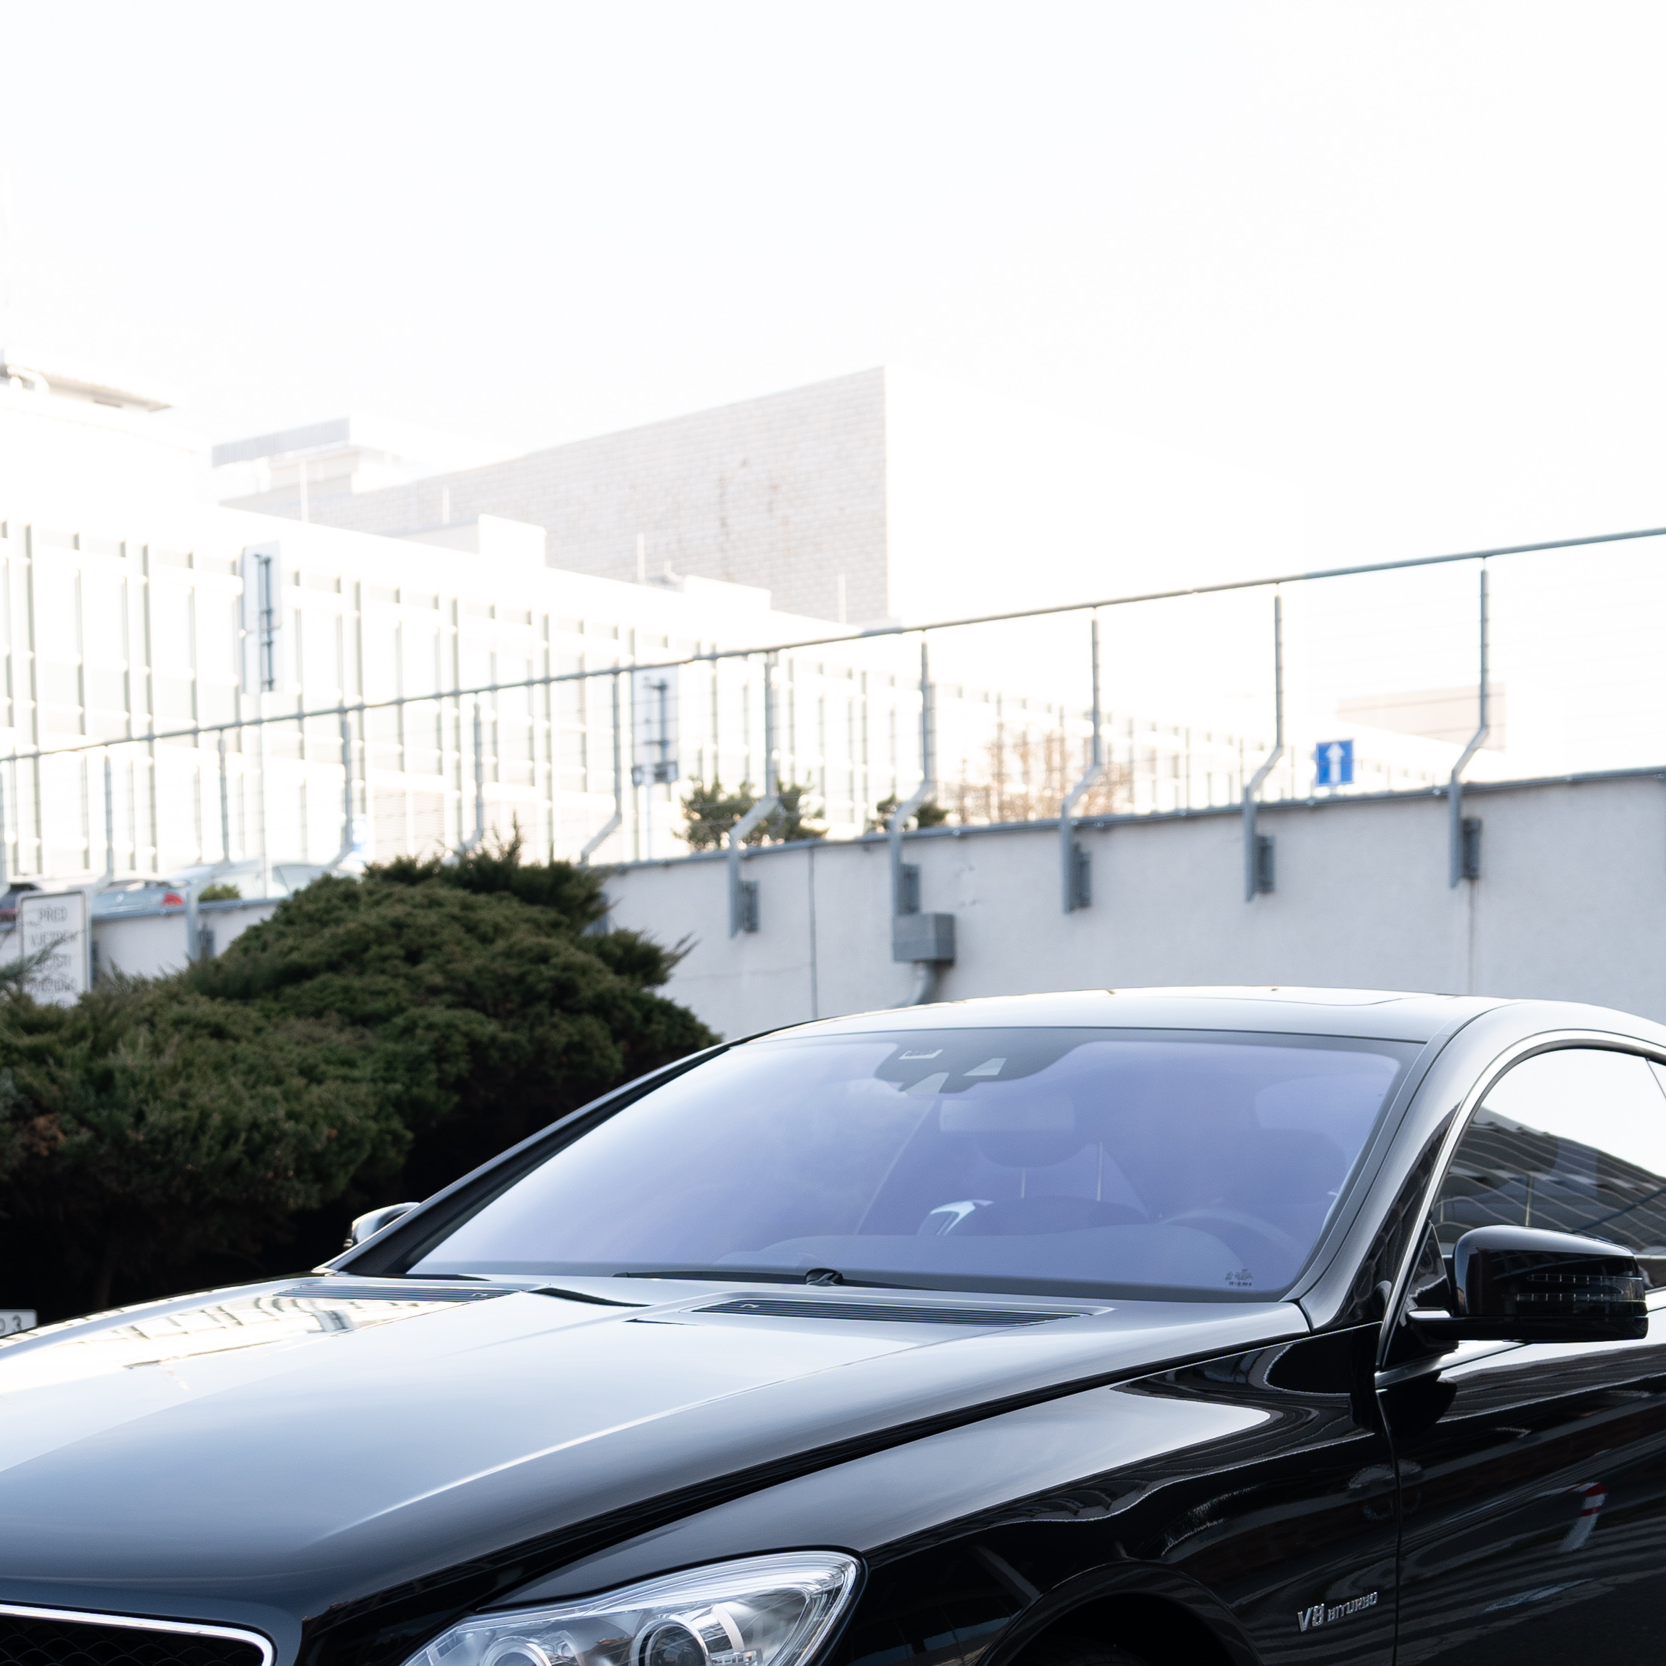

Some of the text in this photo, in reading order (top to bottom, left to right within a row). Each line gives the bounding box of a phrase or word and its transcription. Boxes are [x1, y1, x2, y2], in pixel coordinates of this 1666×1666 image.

[12, 1314, 22, 1332] 3
[1297, 1591, 1378, 1632] V8 BITURBO
